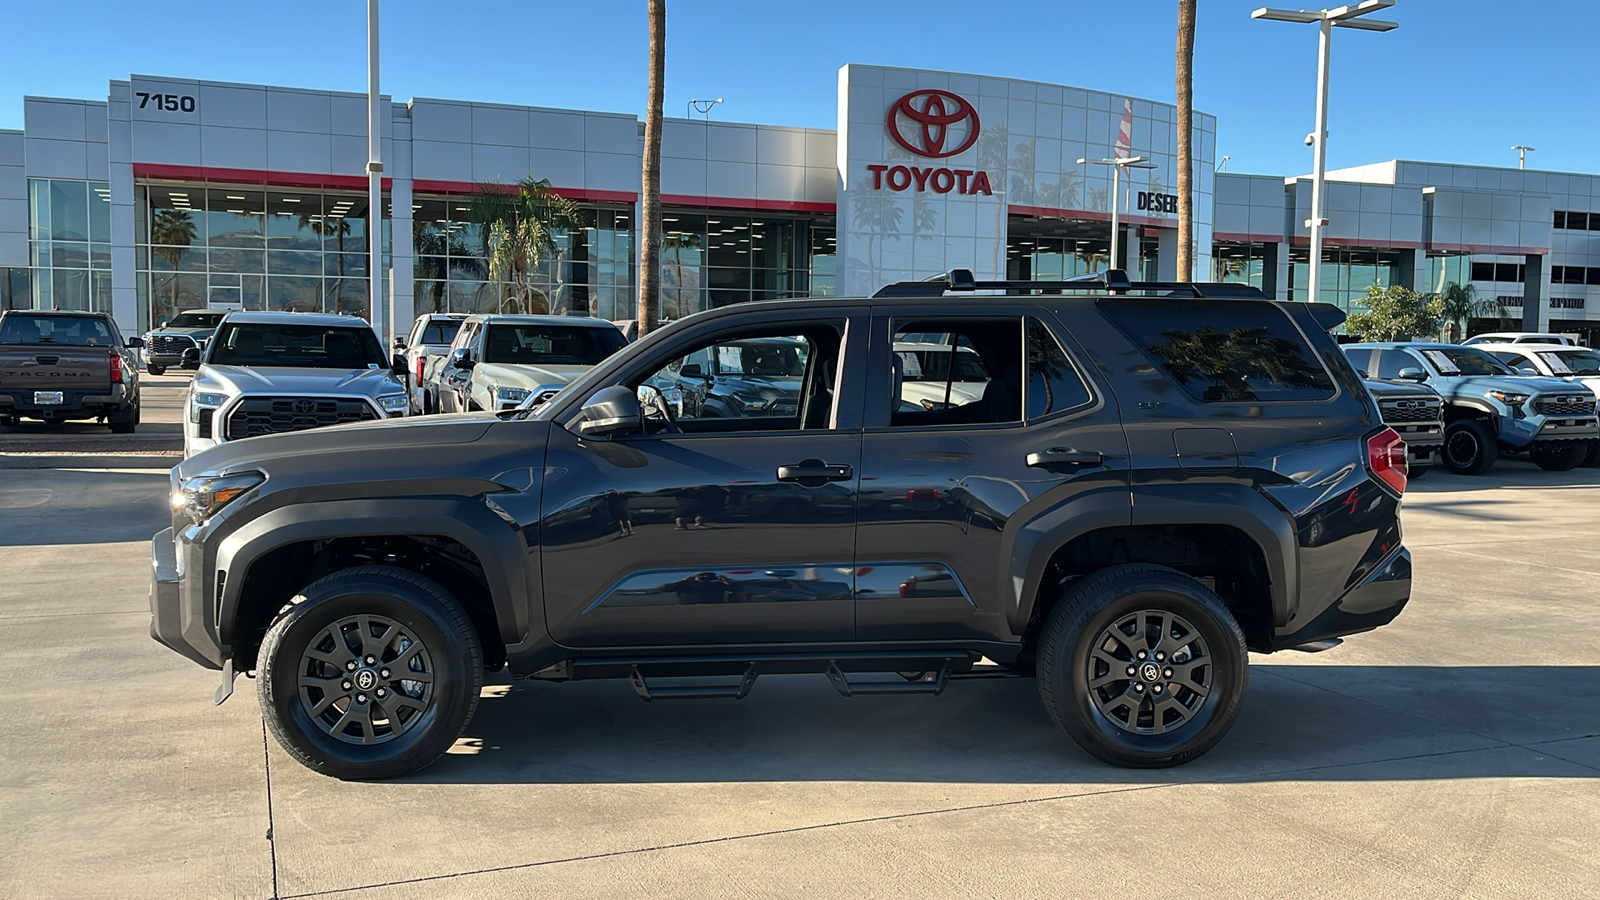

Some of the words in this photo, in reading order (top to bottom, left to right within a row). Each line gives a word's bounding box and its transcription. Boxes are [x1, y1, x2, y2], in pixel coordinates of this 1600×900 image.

[136, 92, 196, 113] 7150
[866, 164, 992, 196] TOYOTA
[1137, 191, 1179, 214] DESER
